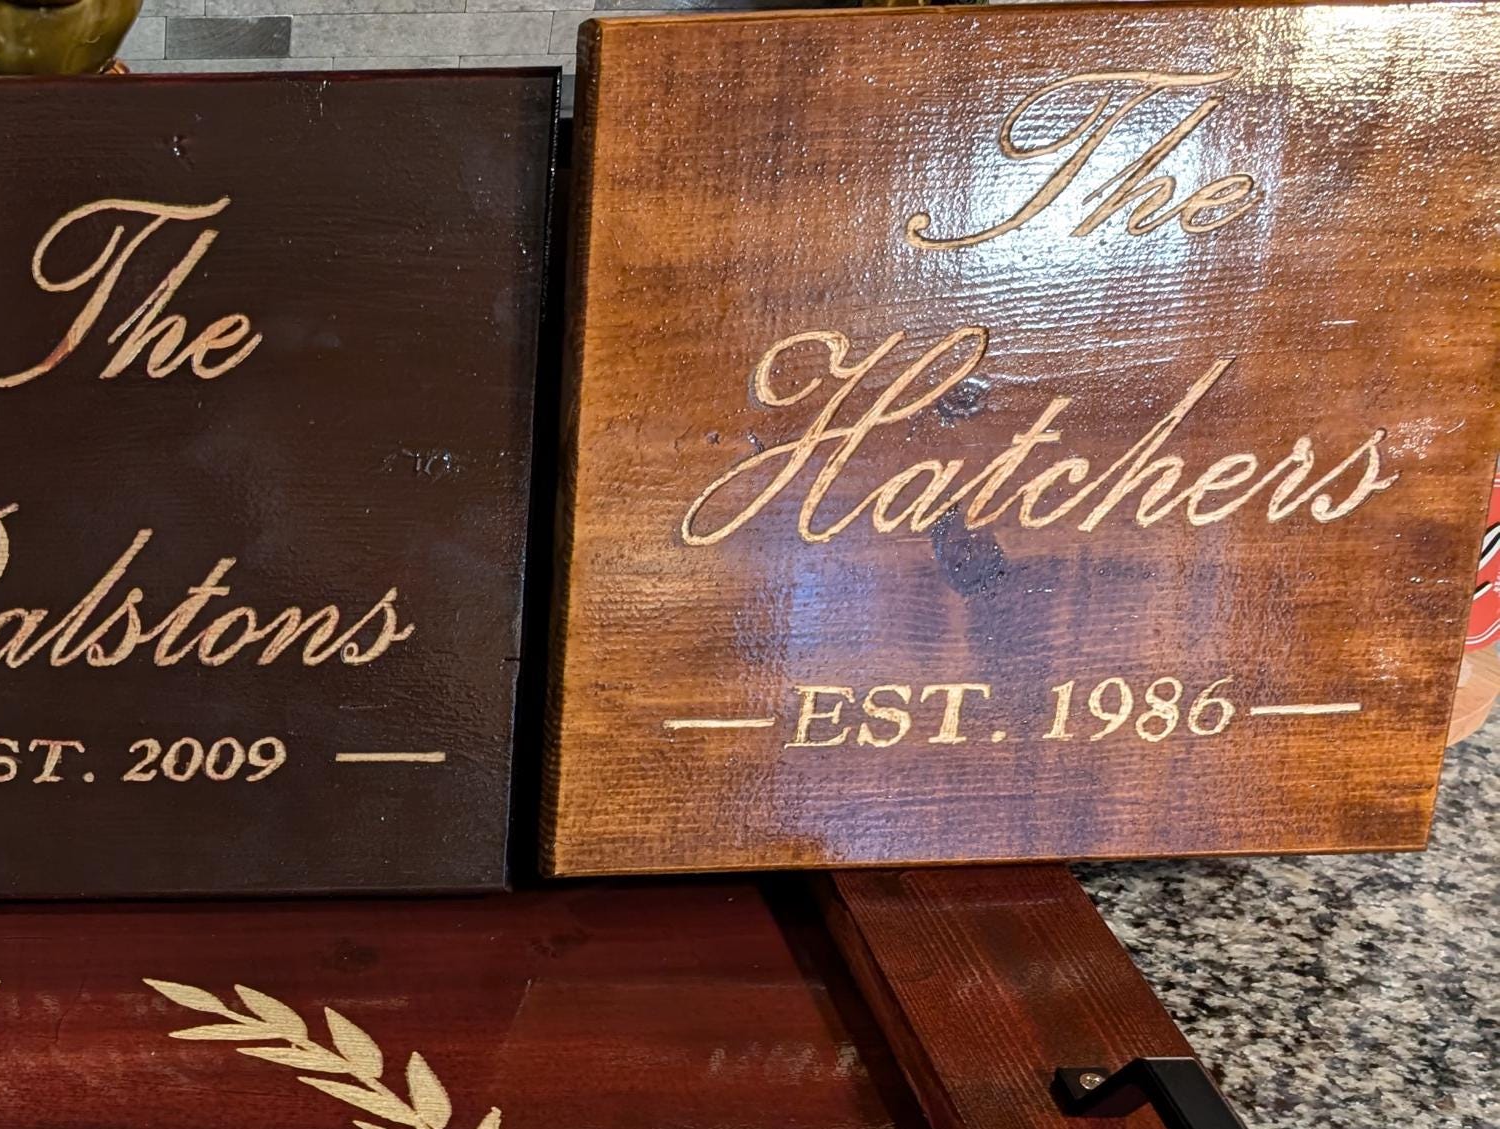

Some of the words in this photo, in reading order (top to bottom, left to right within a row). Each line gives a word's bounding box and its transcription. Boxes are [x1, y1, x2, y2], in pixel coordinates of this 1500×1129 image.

[901, 69, 1262, 248] The
[681, 326, 1399, 547] Hatchers
[122, 736, 287, 783] 2009
[785, 683, 1005, 748] EST.
[1043, 675, 1238, 742] 1986
